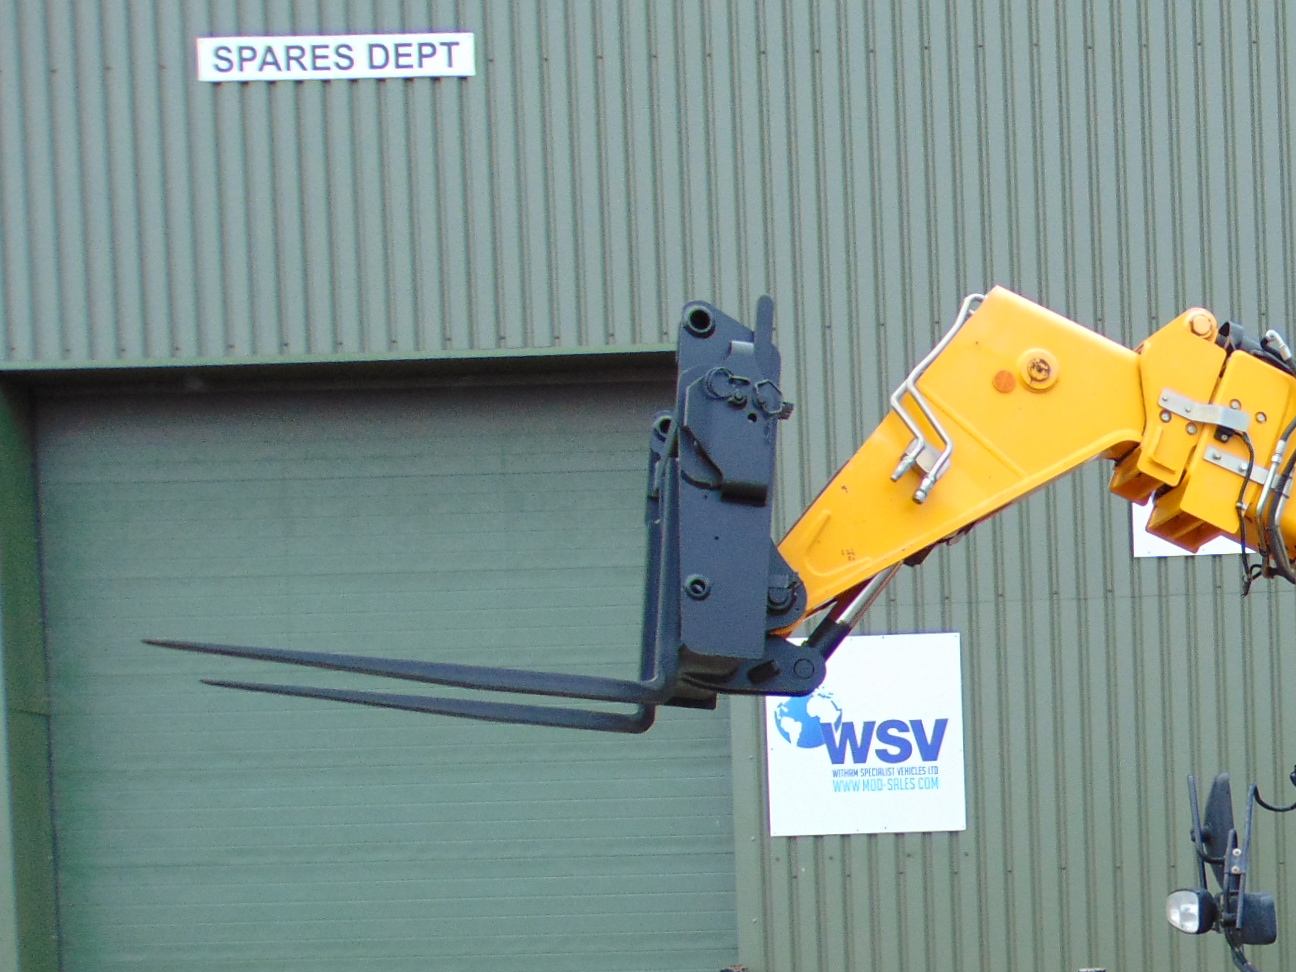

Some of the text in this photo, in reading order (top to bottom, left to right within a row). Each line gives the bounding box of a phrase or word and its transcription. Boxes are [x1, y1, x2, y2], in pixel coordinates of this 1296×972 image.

[214, 41, 460, 73] SPARES DEPT
[820, 717, 949, 765] WSV
[832, 765, 939, 778] WITHAM SPECIALIST VEHICLES LTD
[832, 777, 939, 792] WWWMOD-SALESCOM
